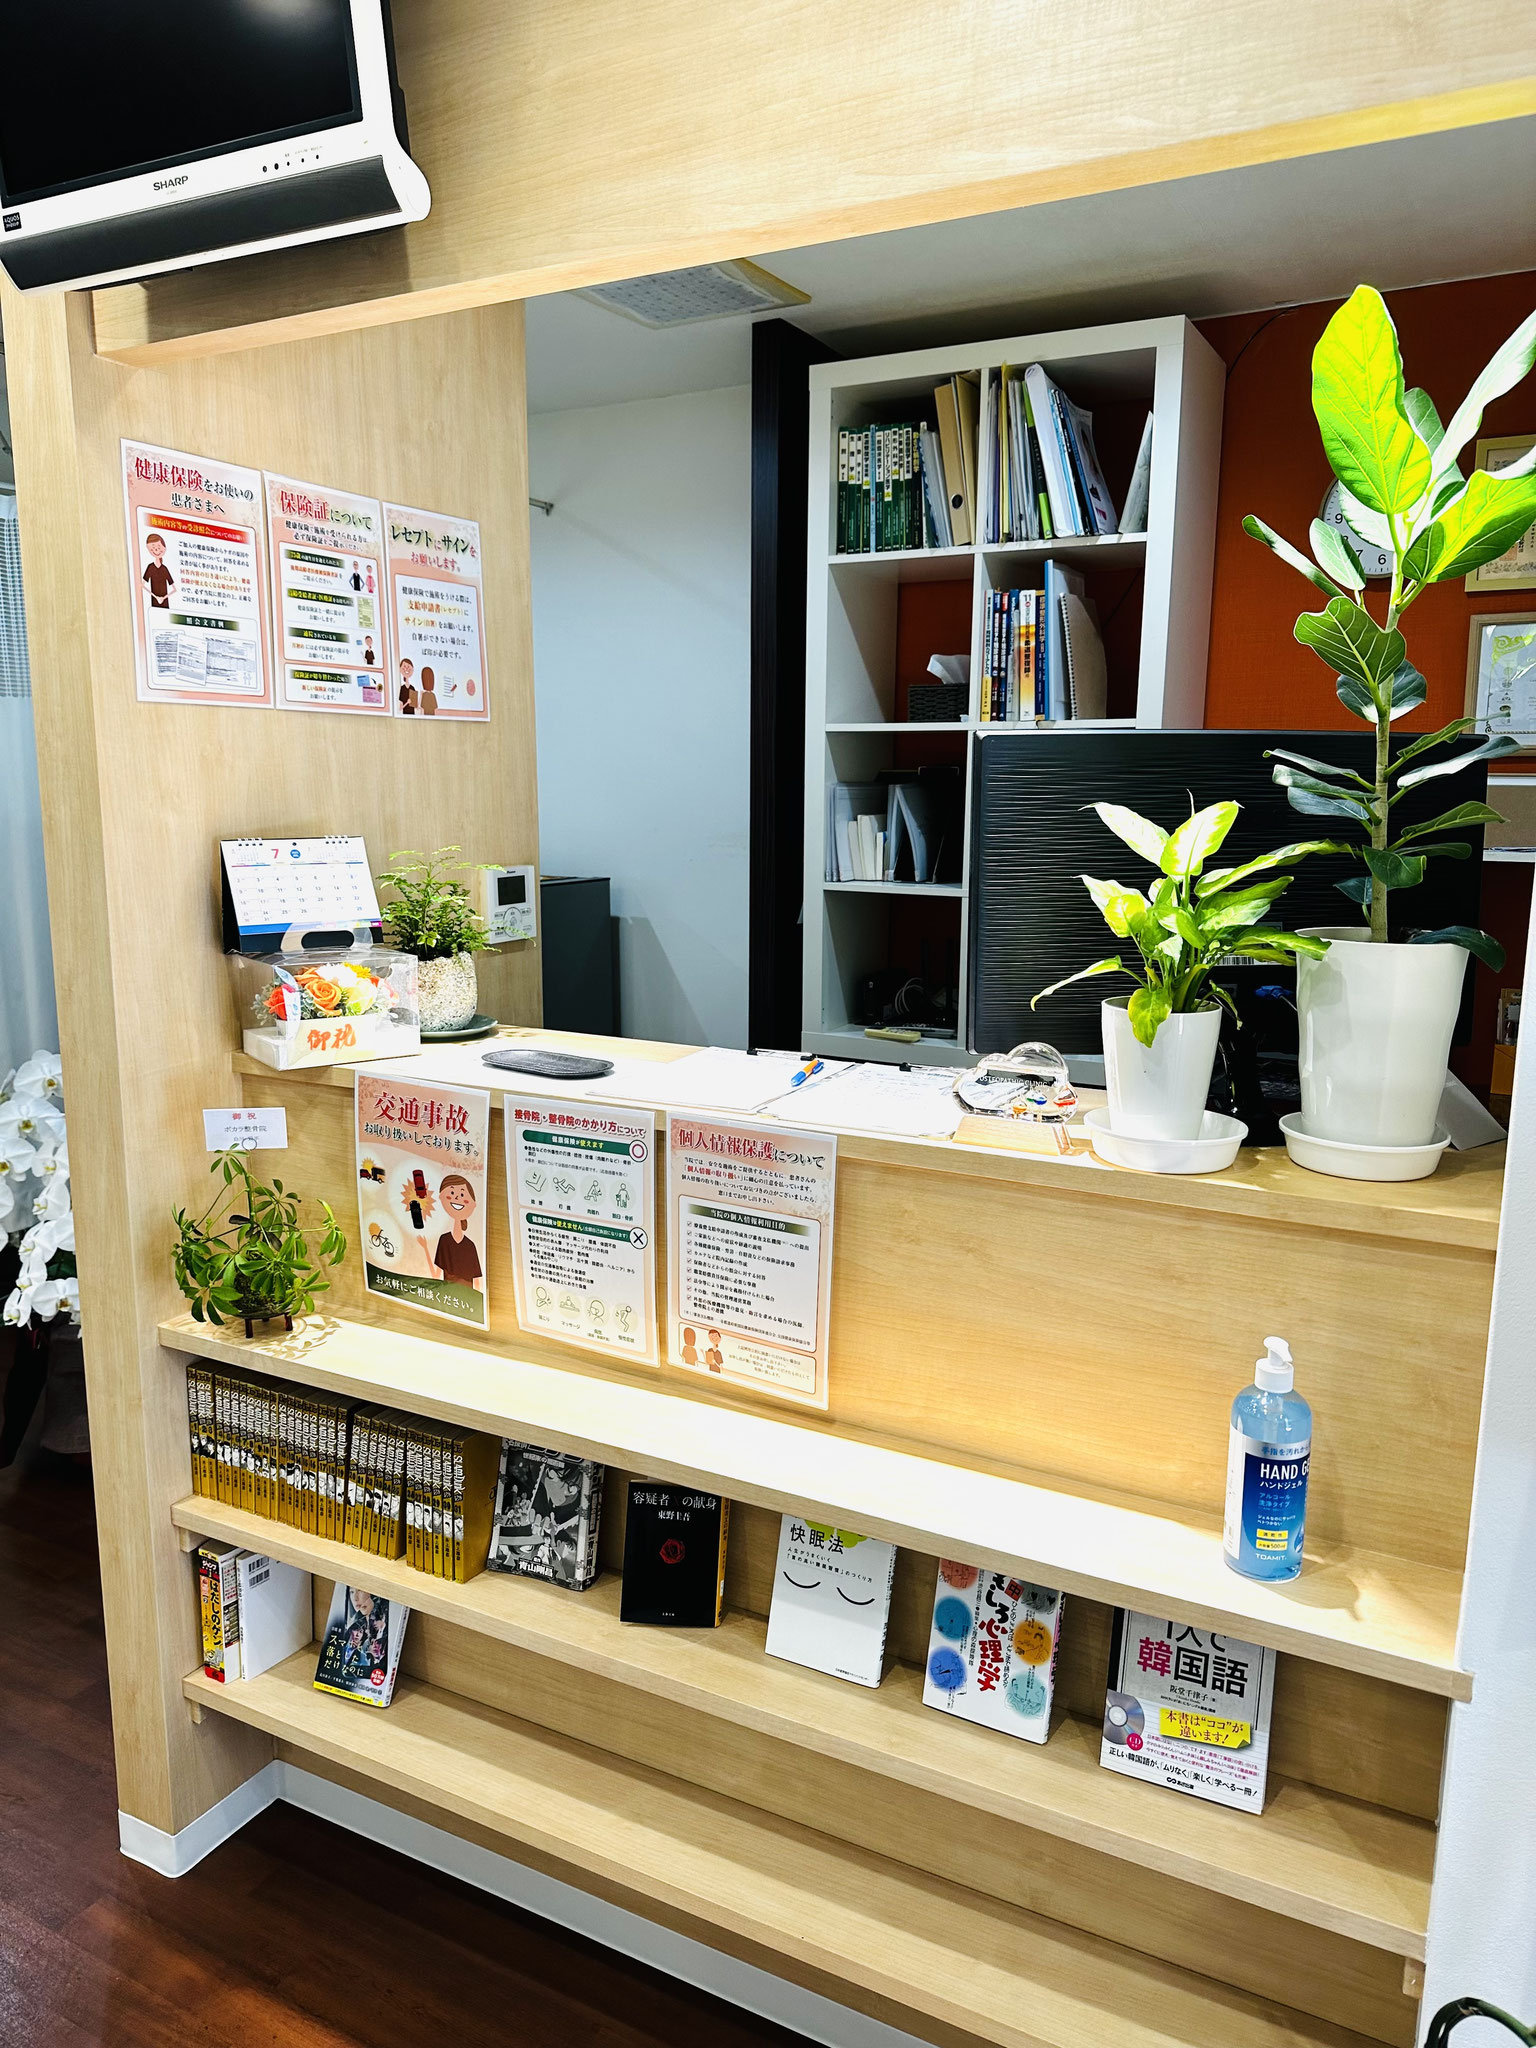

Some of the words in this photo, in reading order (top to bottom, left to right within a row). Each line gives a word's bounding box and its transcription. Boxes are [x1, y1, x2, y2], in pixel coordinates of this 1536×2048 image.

[153, 176, 188, 191] SHARP
[135, 457, 254, 500] 健康保険をお使いの
[171, 493, 225, 514] 患者さまへ
[280, 490, 372, 531] 保険証について
[1334, 513, 1344, 524] 9
[391, 524, 476, 558] レセプトにサインを
[411, 551, 460, 572] お願いします。
[1377, 553, 1387, 565] 6
[271, 849, 279, 859] 7
[1024, 1079, 1048, 1087] CLINIC
[374, 1091, 470, 1135] 交通事故
[514, 1109, 645, 1137] 接骨院・整骨院のかかり方について
[364, 1122, 480, 1157] お取り扱いしております。
[552, 1136, 603, 1149] 健康保険が使えます
[679, 1128, 825, 1170] 個人情報保護について
[711, 1208, 785, 1231] 当院の個人情報利用目的
[376, 1274, 474, 1313] お気軽にご相談ください。
[1260, 1463, 1299, 1480] HAND
[1259, 1480, 1303, 1490] ハンドジェル
[658, 1510, 691, 1521] 東野圭吾
[790, 1523, 844, 1554] 快眠法
[788, 1547, 831, 1563] 人生がうまくいく
[209, 1580, 222, 1647] はだしのゲン
[324, 1660, 363, 1677] だけなのに
[1137, 1636, 1249, 1698] 韓国語
[1169, 1684, 1209, 1702] 阪堂千津子
[1166, 1710, 1244, 1733] 本書は“ココ”が
